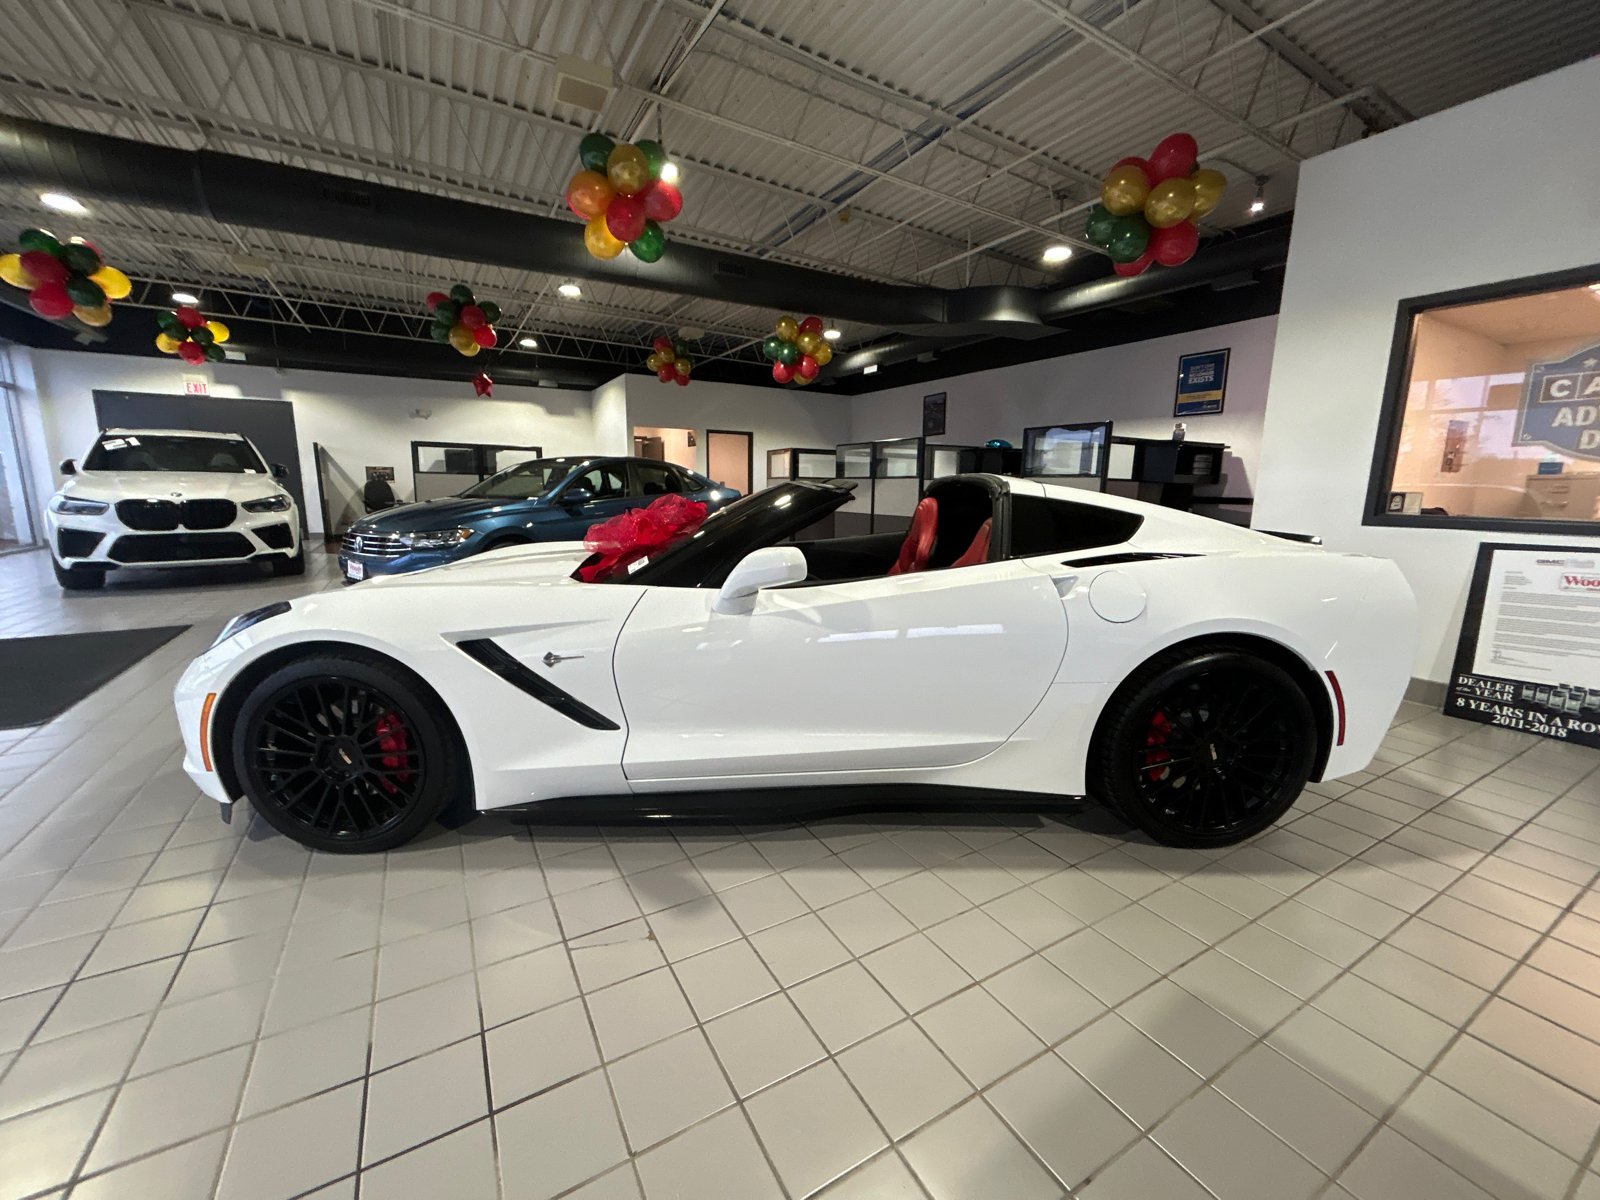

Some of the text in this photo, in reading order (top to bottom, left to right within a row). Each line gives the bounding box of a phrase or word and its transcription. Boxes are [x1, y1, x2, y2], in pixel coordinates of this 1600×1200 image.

[186, 382, 207, 394] EXIT
[1188, 375, 1214, 384] EXISTS
[1550, 376, 1600, 398] CA
[1551, 405, 1600, 427] AD
[101, 436, 141, 451] 21
[1579, 429, 1600, 450] D
[1458, 676, 1515, 693] DEALER
[1475, 687, 1513, 701] YEAR
[1456, 697, 1600, 733] 8 YEARS IN A RO
[1491, 714, 1568, 738] 2011-2018
